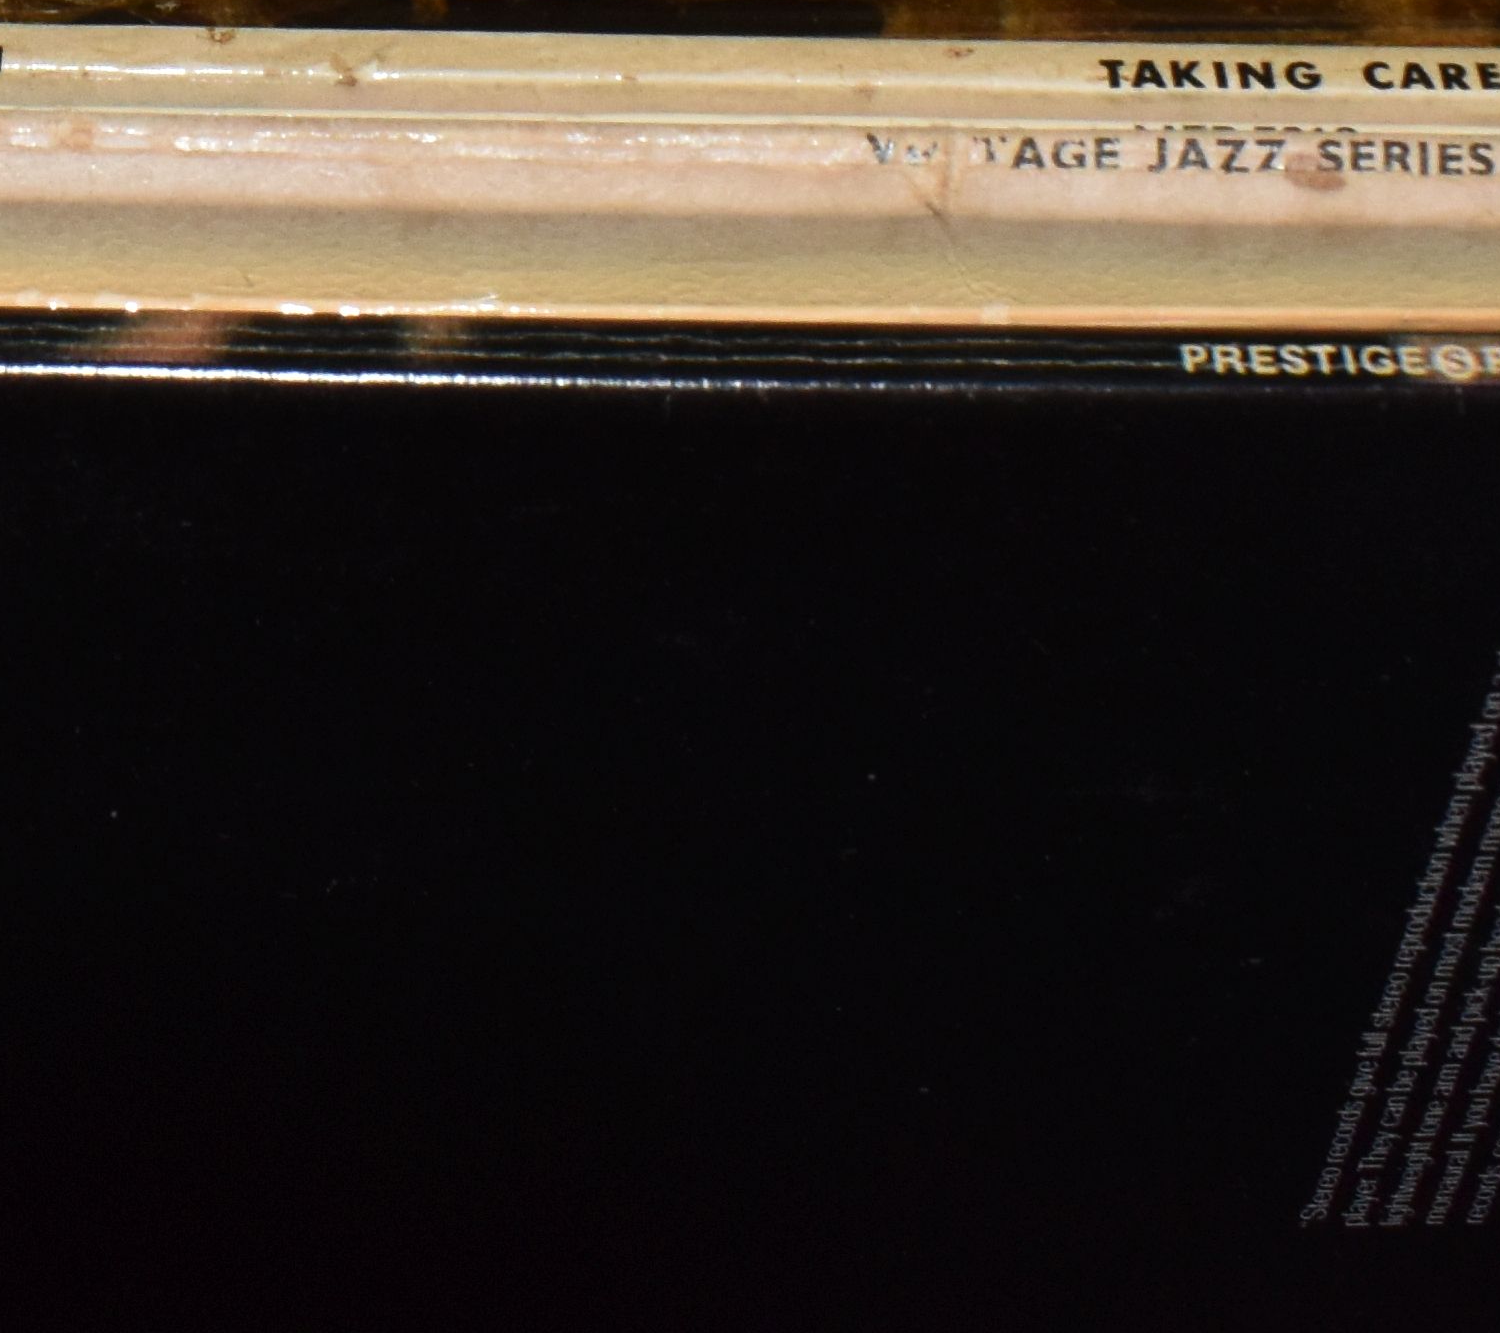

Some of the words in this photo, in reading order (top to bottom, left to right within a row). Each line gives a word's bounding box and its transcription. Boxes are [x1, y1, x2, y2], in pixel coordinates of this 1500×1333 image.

[1098, 58, 1324, 91] TAKING
[1147, 137, 1285, 173] JAZZ
[1315, 142, 1496, 178] SERIES
[1178, 343, 1429, 379] PRESTIGE
[1452, 722, 1498, 791] played
[1434, 794, 1473, 846] when
[1371, 971, 1410, 1028] stereo
[1356, 1032, 1388, 1059] full
[1350, 1060, 1379, 1096] give
[1327, 1100, 1365, 1165] records
